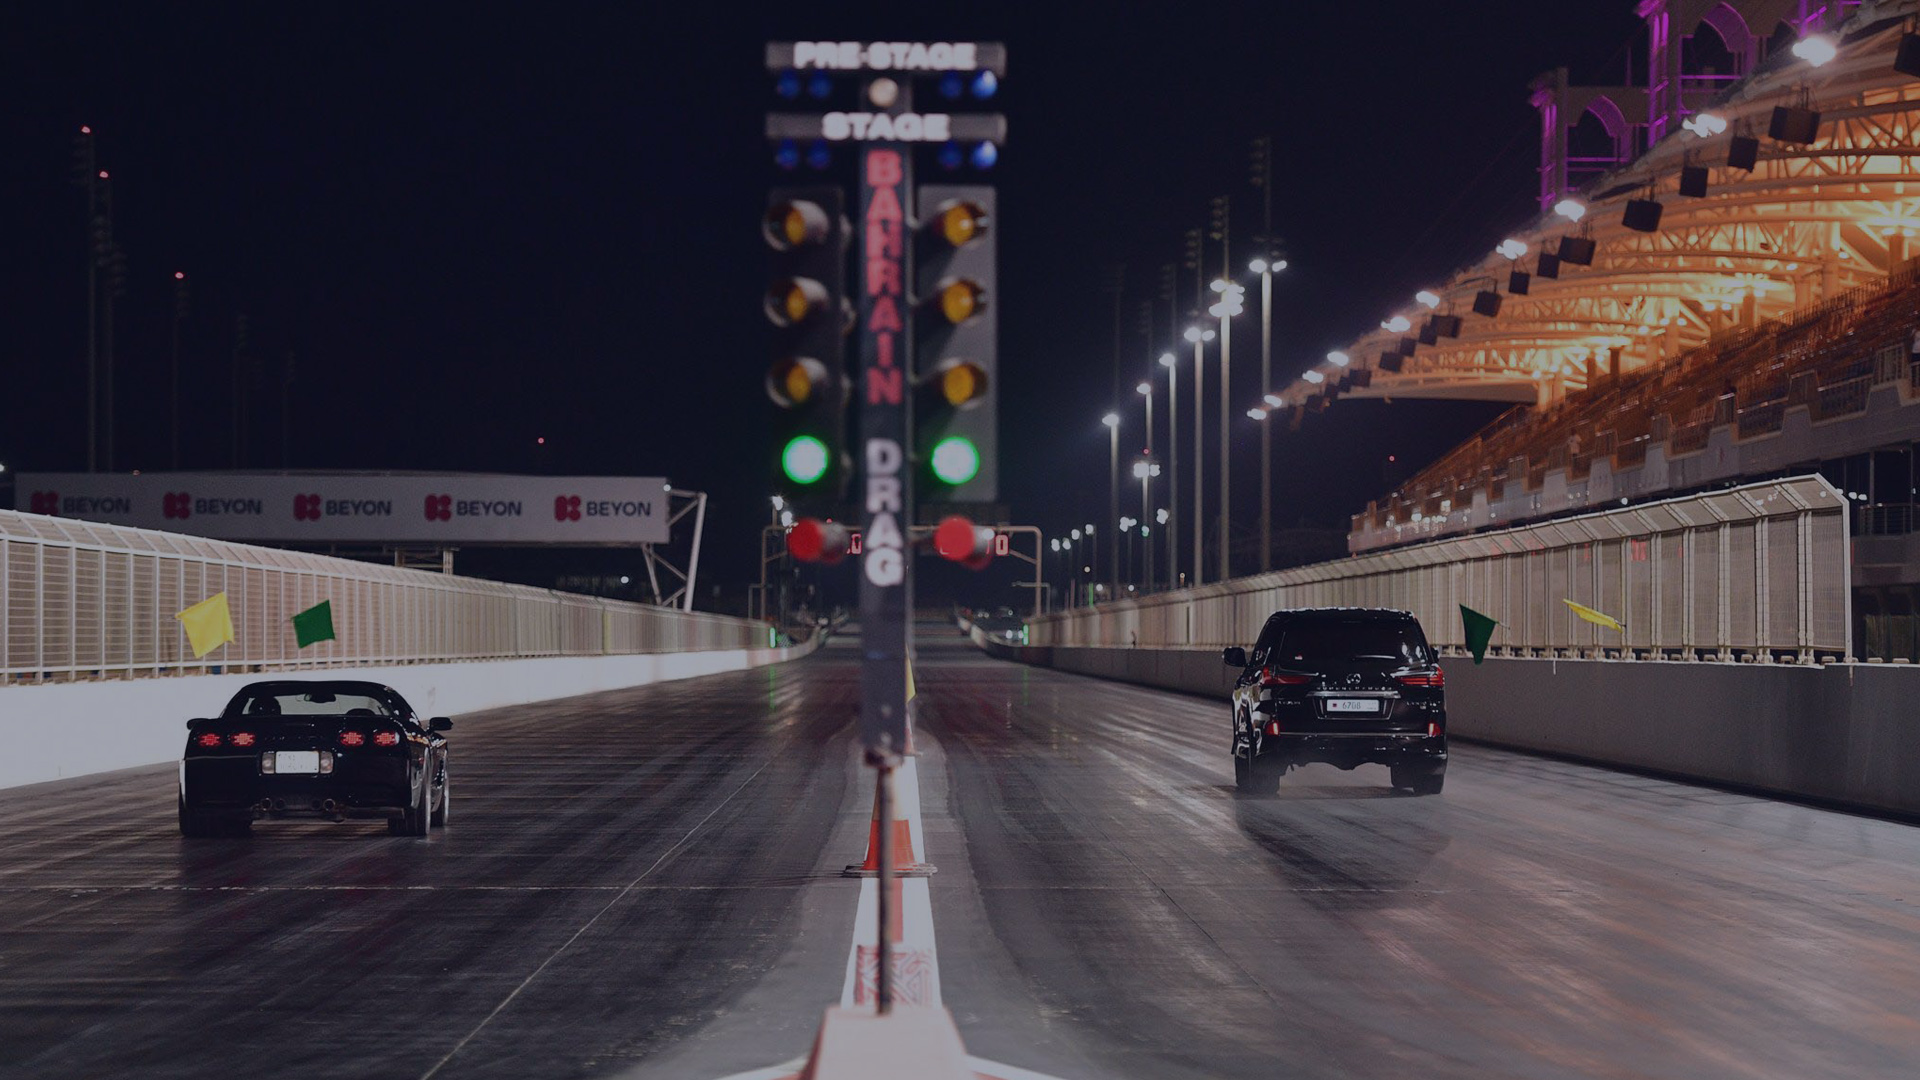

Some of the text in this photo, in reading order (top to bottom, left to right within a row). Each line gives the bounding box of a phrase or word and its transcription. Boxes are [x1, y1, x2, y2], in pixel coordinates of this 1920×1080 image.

[794, 41, 977, 70] PRE-STAGE
[822, 112, 949, 141] STAGE
[865, 149, 904, 587] BAHRAIN DRAG
[63, 497, 131, 514] BEYON
[195, 499, 261, 515] BEYON
[326, 500, 392, 516] BEYON
[456, 500, 522, 516] BEYON
[586, 501, 651, 516] BEYON
